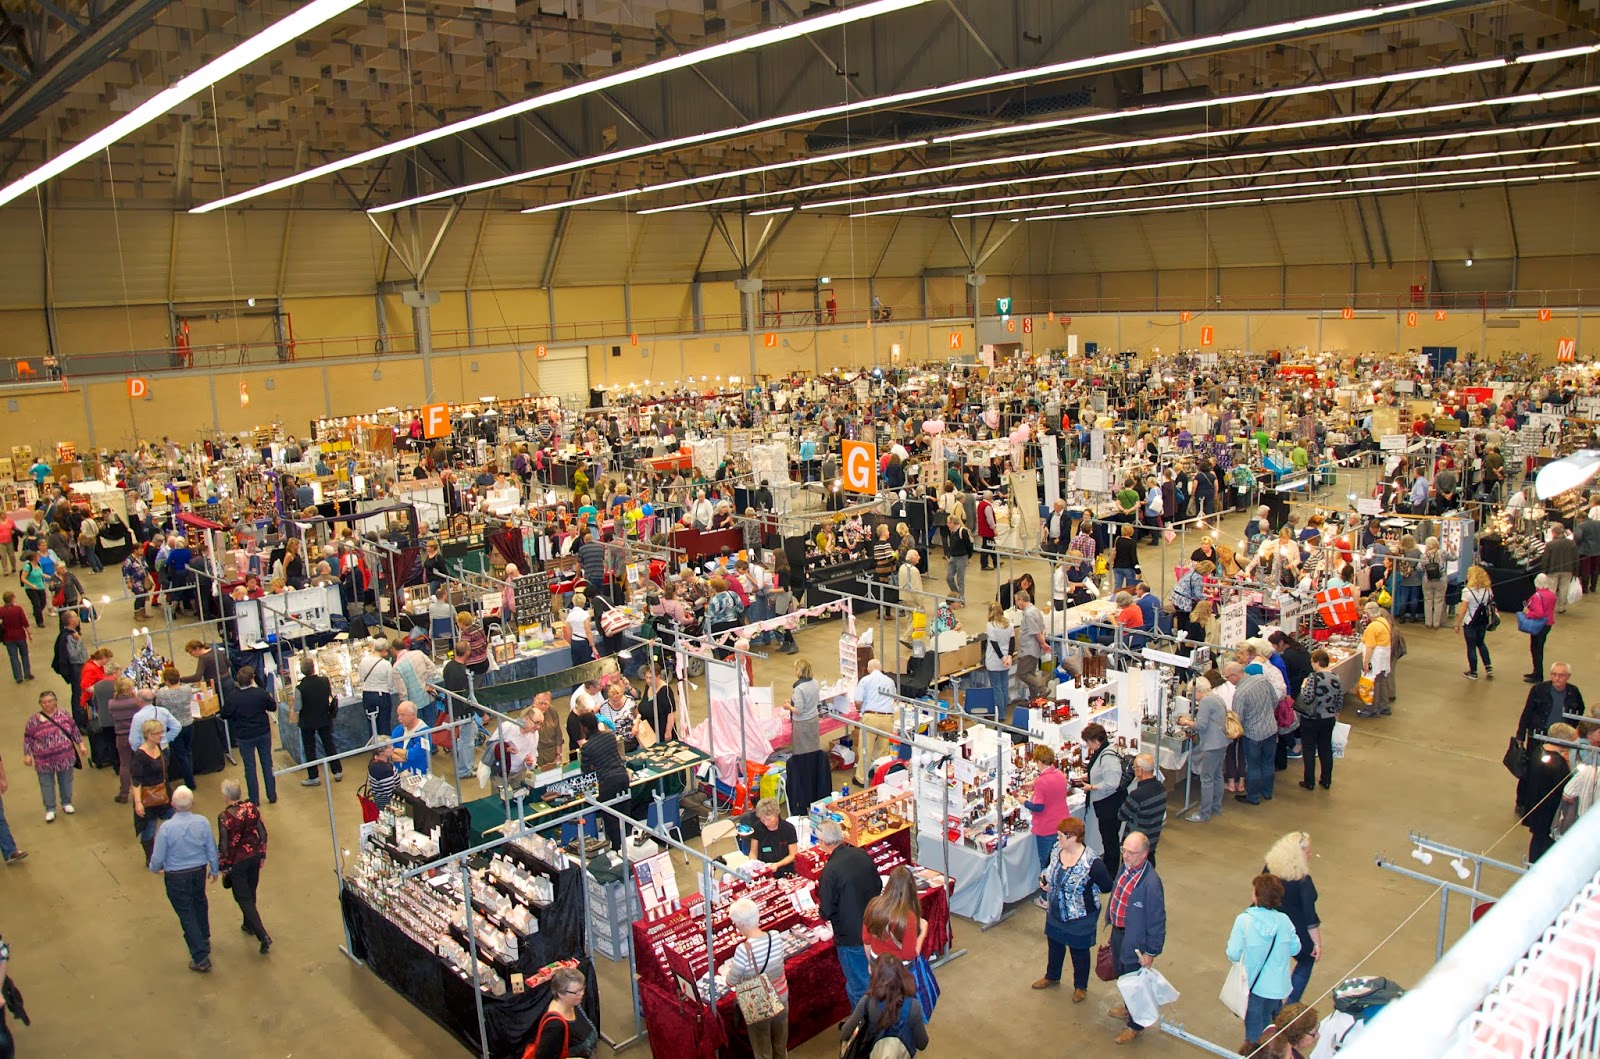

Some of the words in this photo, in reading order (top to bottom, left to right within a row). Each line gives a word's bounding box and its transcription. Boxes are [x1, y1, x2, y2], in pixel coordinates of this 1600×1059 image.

[1557, 340, 1574, 360] M
[131, 379, 145, 397] D
[429, 406, 444, 436] F
[847, 446, 870, 488] G
